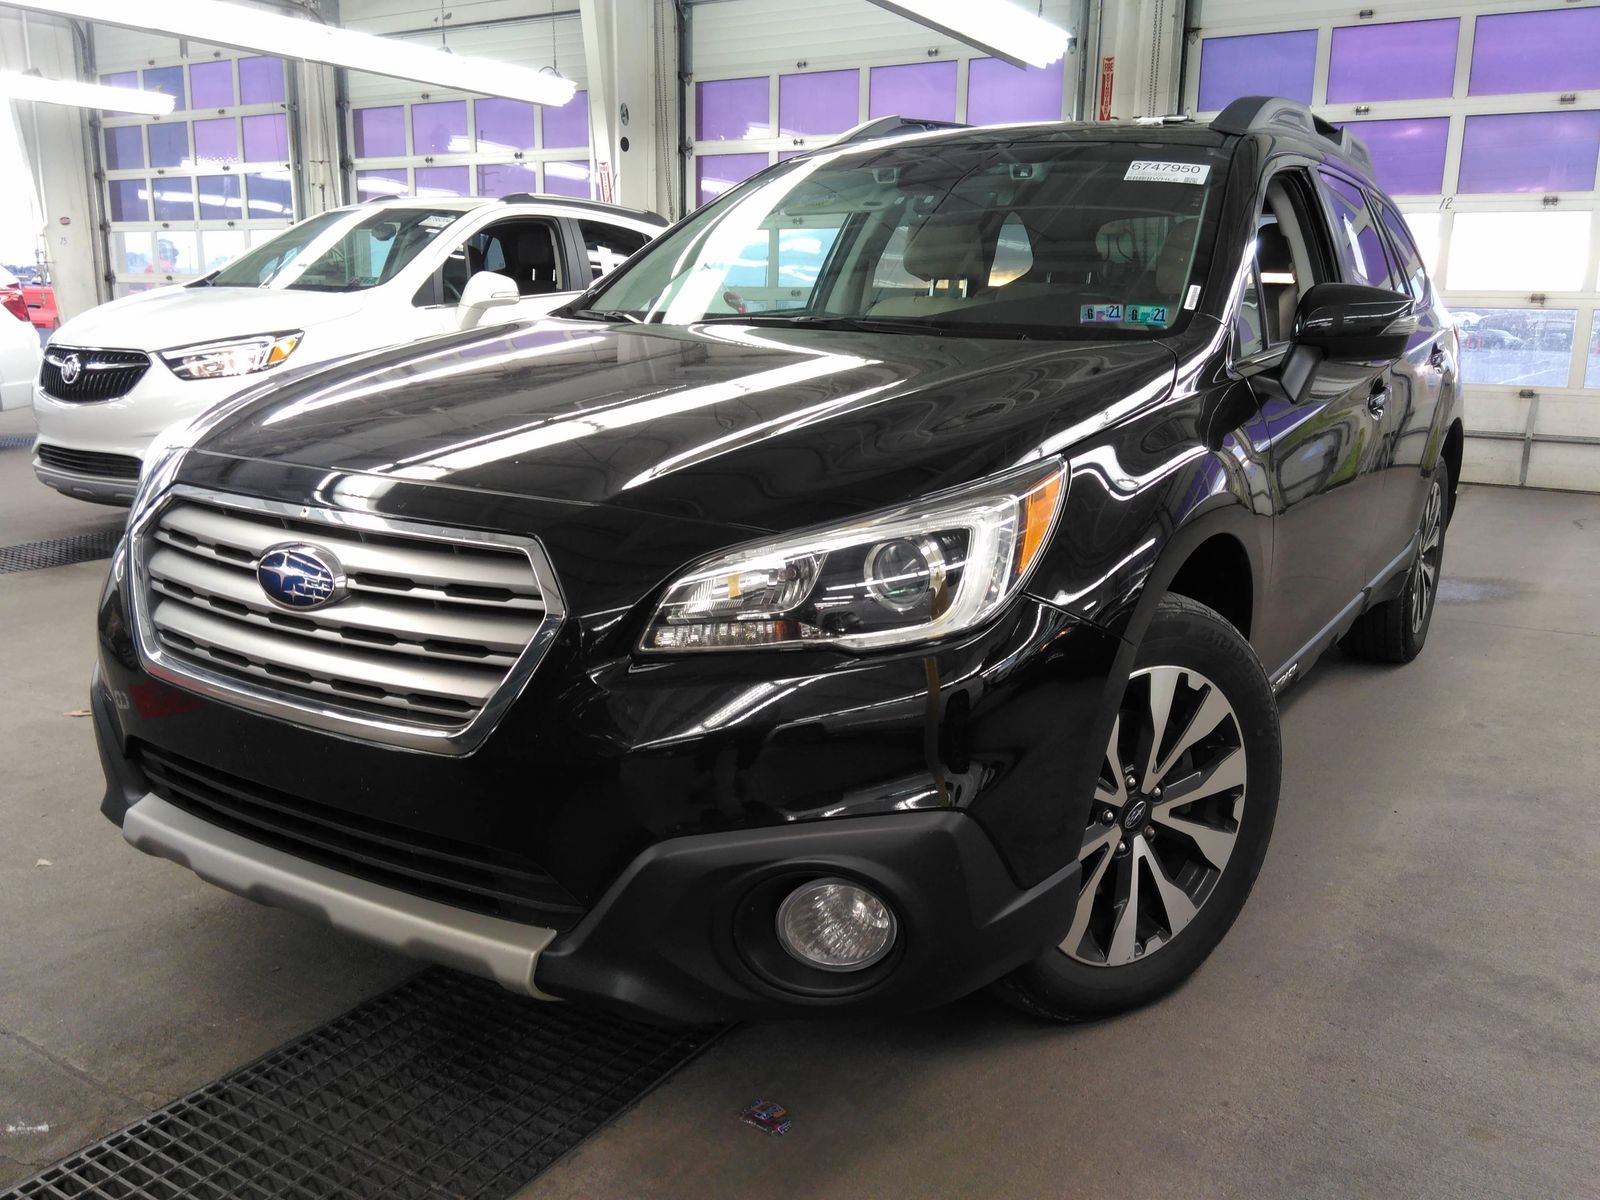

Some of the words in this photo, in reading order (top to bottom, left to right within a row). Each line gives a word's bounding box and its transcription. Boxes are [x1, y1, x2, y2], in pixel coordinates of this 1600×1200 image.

[1131, 162, 1201, 174] 6747950
[1439, 196, 1454, 210] 12
[1087, 308, 1094, 320] 6
[1109, 304, 1121, 319] 21
[1131, 309, 1138, 321] 6
[1153, 308, 1166, 322] 21
